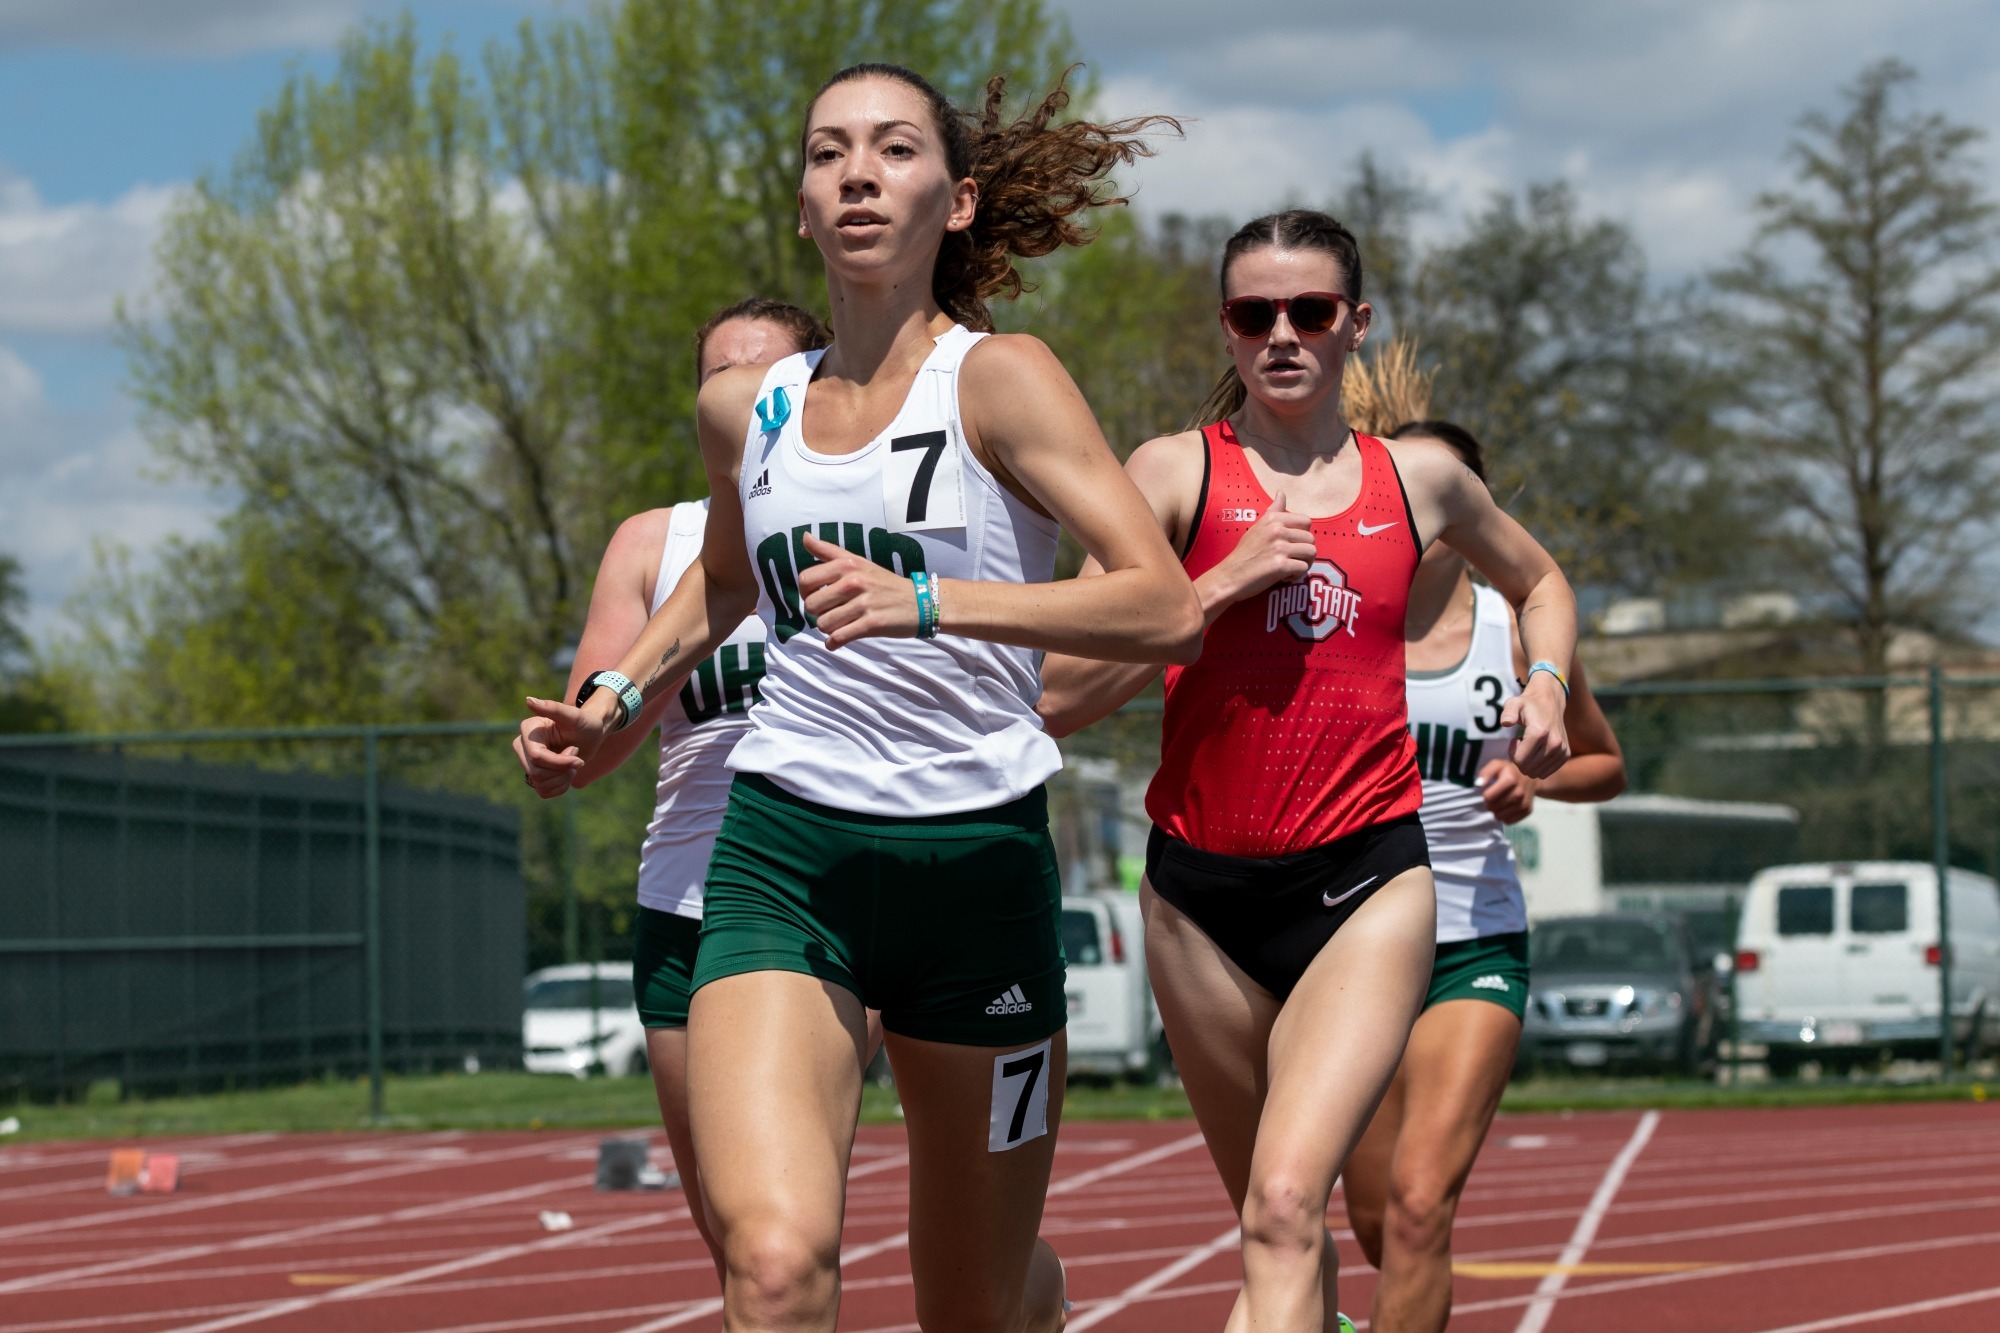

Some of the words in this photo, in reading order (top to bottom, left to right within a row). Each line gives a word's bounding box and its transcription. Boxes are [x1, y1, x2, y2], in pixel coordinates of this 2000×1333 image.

[891, 430, 947, 523] 7
[1474, 675, 1504, 733] 3
[985, 1002, 1032, 1015] adidas
[1003, 1050, 1045, 1143] 7
